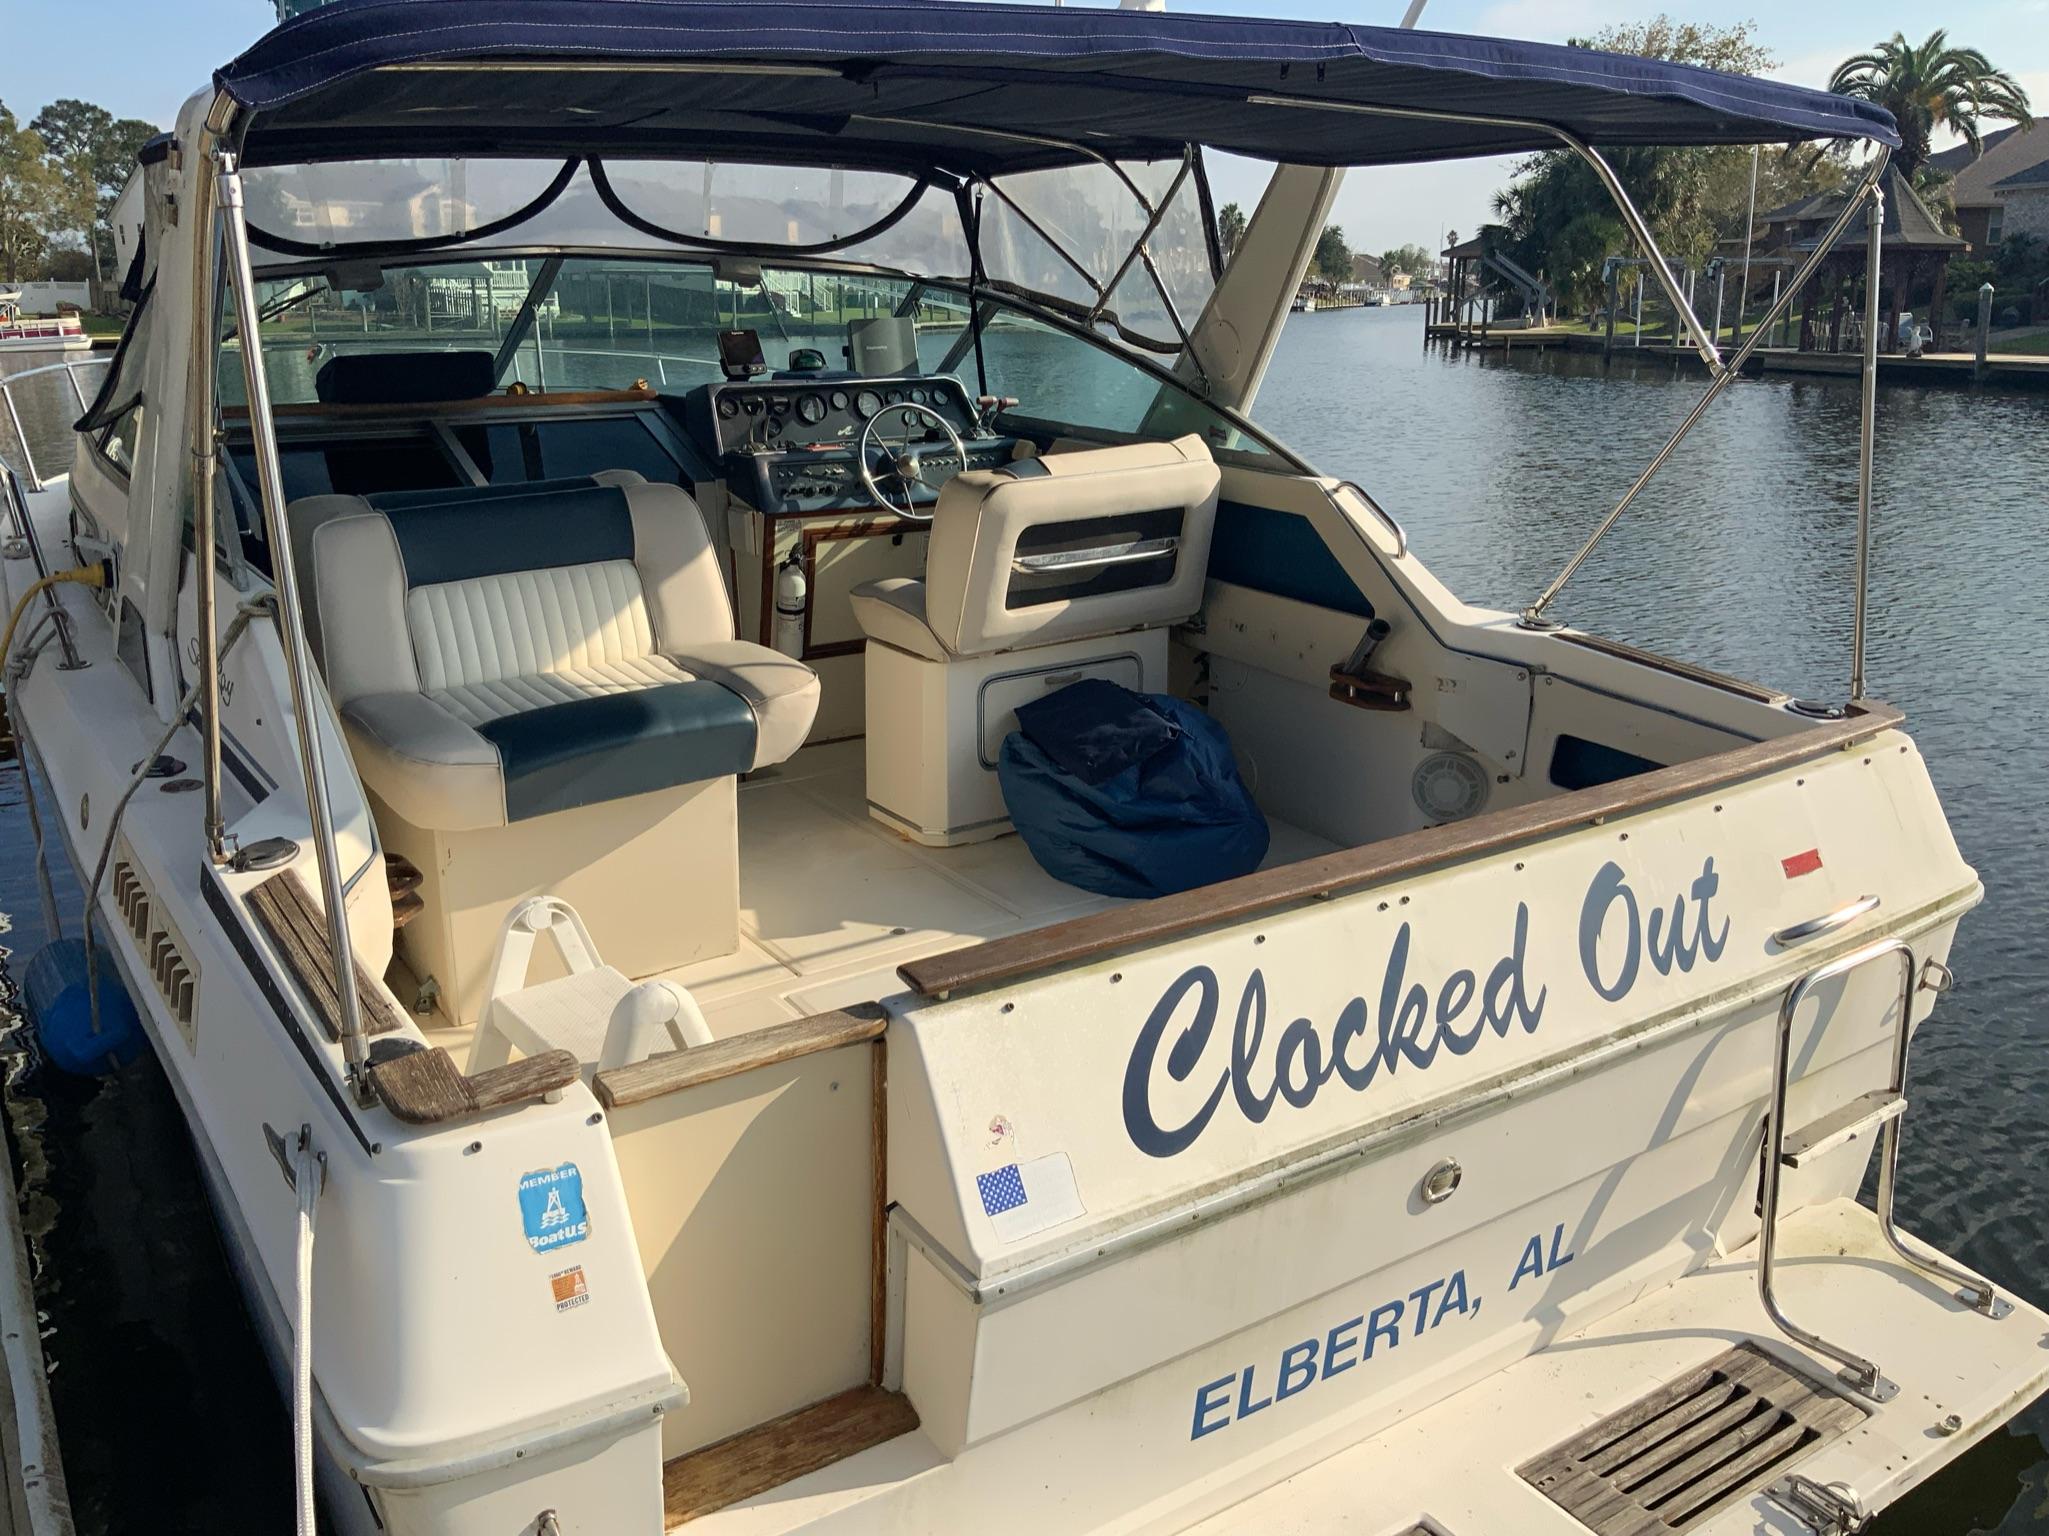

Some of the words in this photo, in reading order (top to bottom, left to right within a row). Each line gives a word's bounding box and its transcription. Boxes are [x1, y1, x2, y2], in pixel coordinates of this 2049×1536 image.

[1122, 901, 1547, 1158] Clocked
[1579, 856, 1731, 1003] Out
[520, 1168, 577, 1190] MEMBER
[556, 1294, 590, 1310] PROTECTED
[1190, 1269, 1482, 1441] ELBERTA,
[1508, 1224, 1575, 1291] AL
